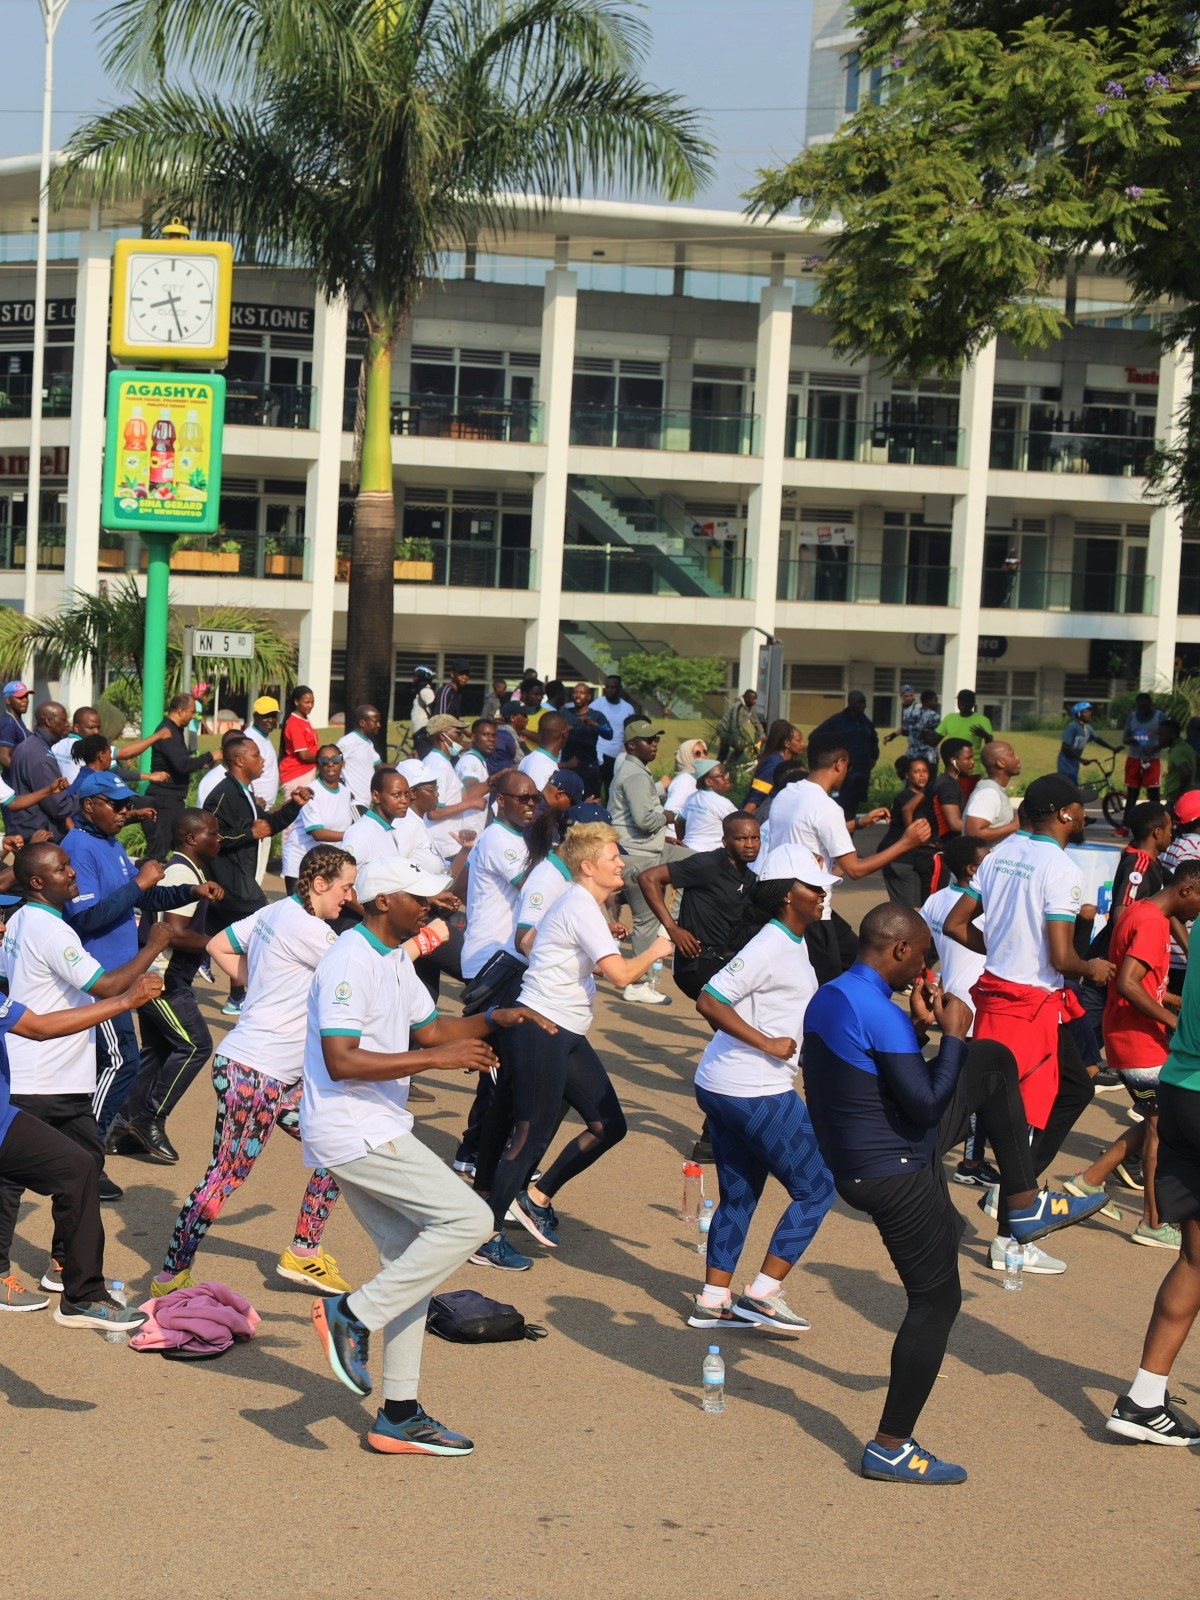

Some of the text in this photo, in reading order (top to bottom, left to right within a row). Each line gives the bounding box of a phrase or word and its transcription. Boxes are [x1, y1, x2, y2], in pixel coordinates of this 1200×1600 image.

[231, 306, 310, 329] KSTONE
[125, 384, 209, 399] AGASHYA
[139, 499, 203, 511] SINA GERARD
[200, 635, 246, 651] KN 5 RD
